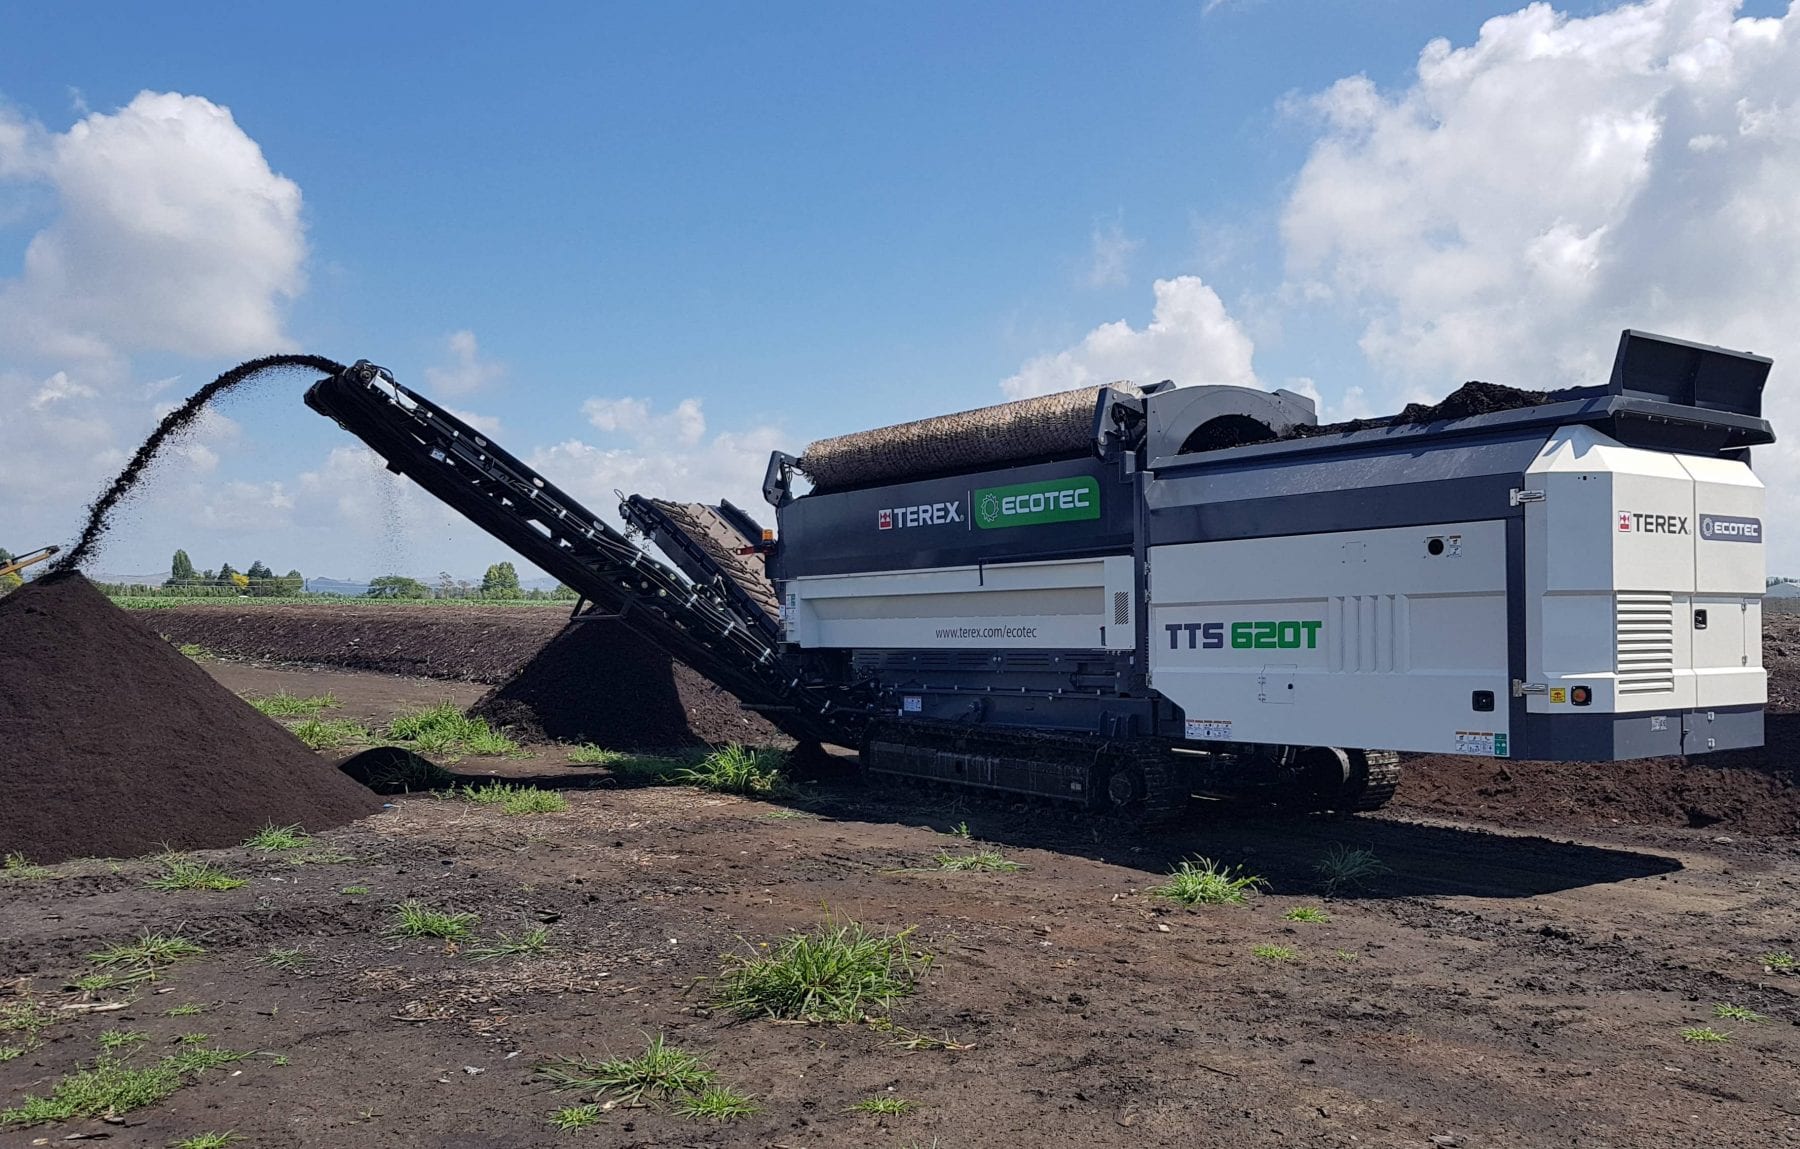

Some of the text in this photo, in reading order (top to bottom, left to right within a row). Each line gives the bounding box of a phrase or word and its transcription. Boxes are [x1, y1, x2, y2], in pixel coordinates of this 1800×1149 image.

[1003, 488, 1089, 514] ECOTEC
[894, 501, 961, 527] TEREX
[1633, 513, 1688, 535] TEREX
[1714, 522, 1758, 536] ECOTEC
[935, 625, 1037, 639] www.terex.com/ecotec
[1165, 621, 1321, 648] TTS 620T
